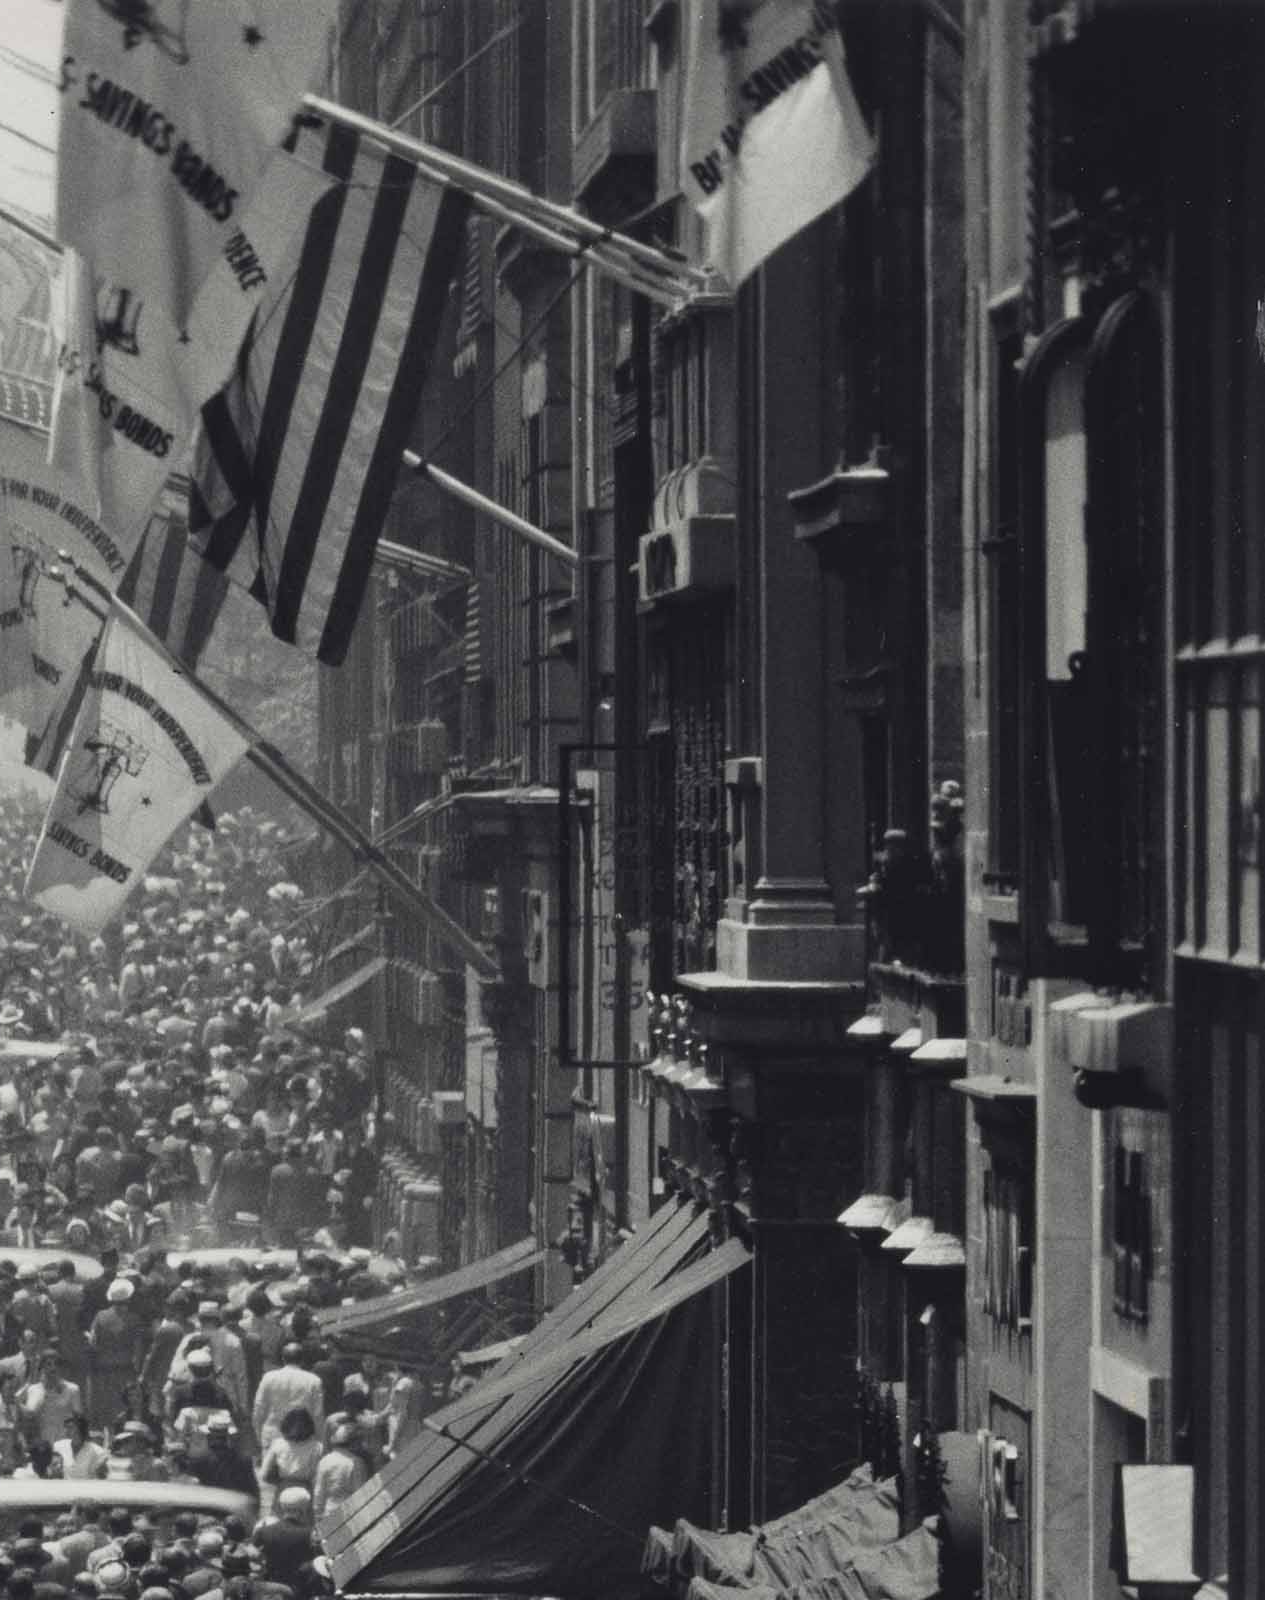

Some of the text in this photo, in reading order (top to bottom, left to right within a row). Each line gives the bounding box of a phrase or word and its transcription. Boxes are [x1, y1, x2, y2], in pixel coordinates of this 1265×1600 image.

[79, 72, 176, 156] SAVINGS
[114, 403, 175, 459] BONDS
[31, 485, 61, 512] YOUR
[58, 501, 127, 574] INDEPENDENCE
[124, 680, 155, 712] YOUR
[152, 705, 214, 786] INDEPENDENCE
[45, 823, 133, 884] SAVINGS BONDS
